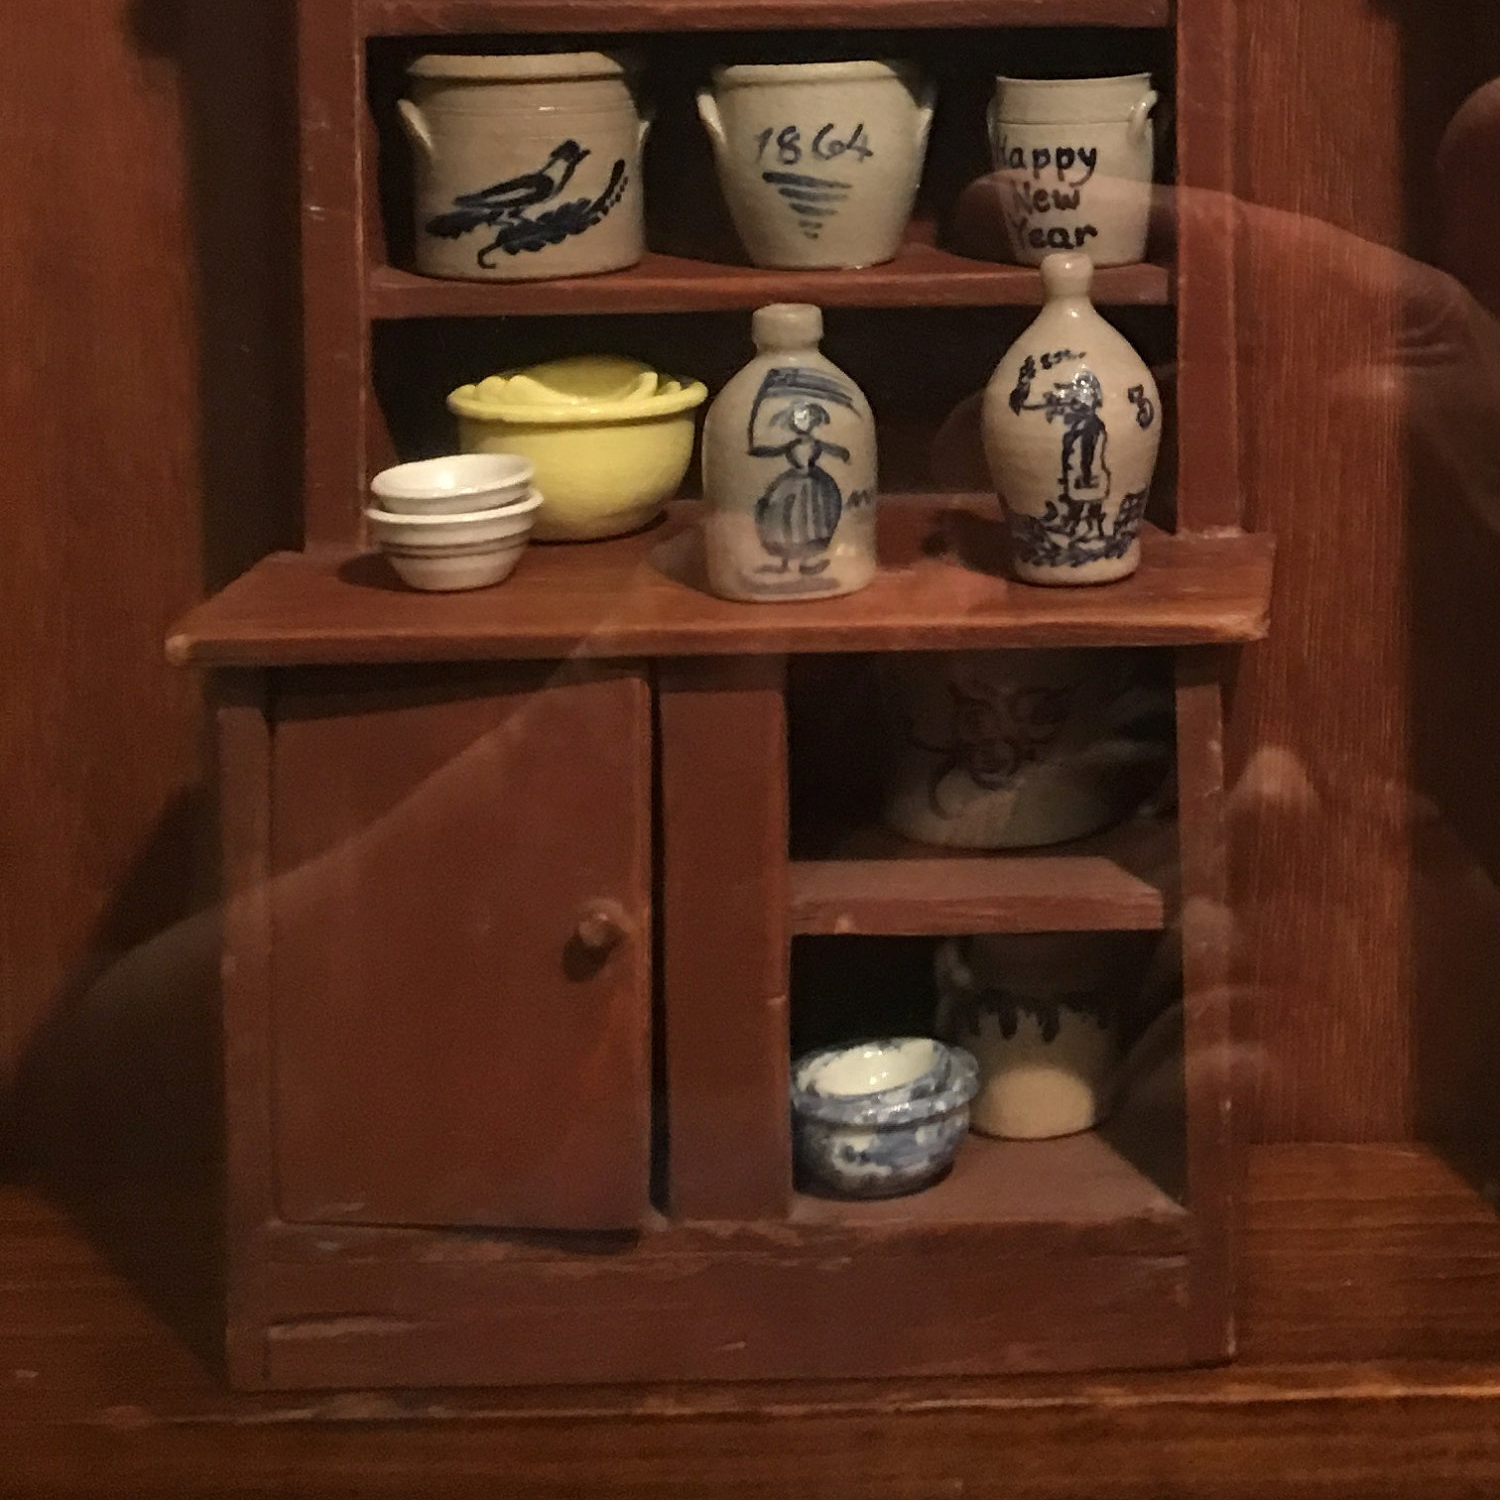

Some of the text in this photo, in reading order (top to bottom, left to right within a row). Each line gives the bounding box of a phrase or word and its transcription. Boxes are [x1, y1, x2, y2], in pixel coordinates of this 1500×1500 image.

[756, 122, 873, 164] 1864
[1011, 180, 1080, 215] New
[1011, 217, 1097, 250] Year
